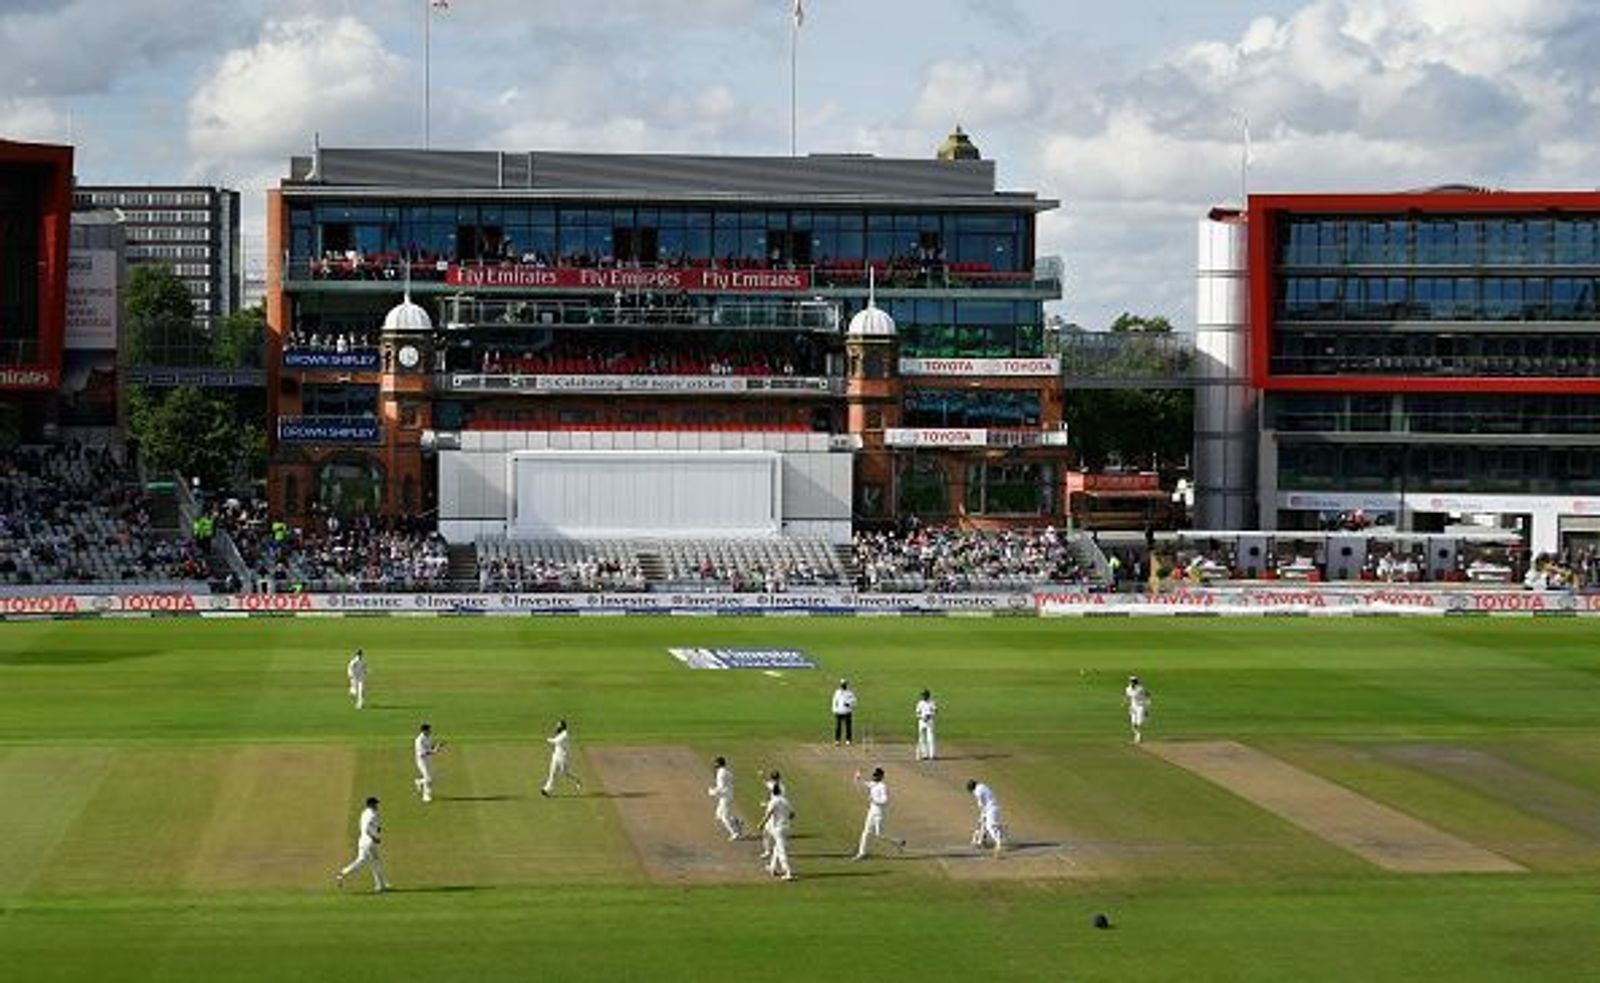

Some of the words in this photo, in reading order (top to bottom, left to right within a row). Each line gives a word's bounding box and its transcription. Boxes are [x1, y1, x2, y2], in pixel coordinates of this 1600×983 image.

[457, 269, 483, 285] Fly
[487, 267, 557, 284] Emirates
[580, 270, 607, 287] Fly
[703, 272, 728, 289] Fly
[732, 272, 800, 286] Emirates
[924, 361, 973, 371] TOYOTA
[1003, 361, 1052, 371] TOYOTA
[922, 431, 970, 442] TOYOTA
[0, 598, 78, 612] TOYOTA
[119, 595, 195, 610] TOYOTA
[235, 594, 311, 609] TOYOTA
[1475, 594, 1545, 610] TOYOTA
